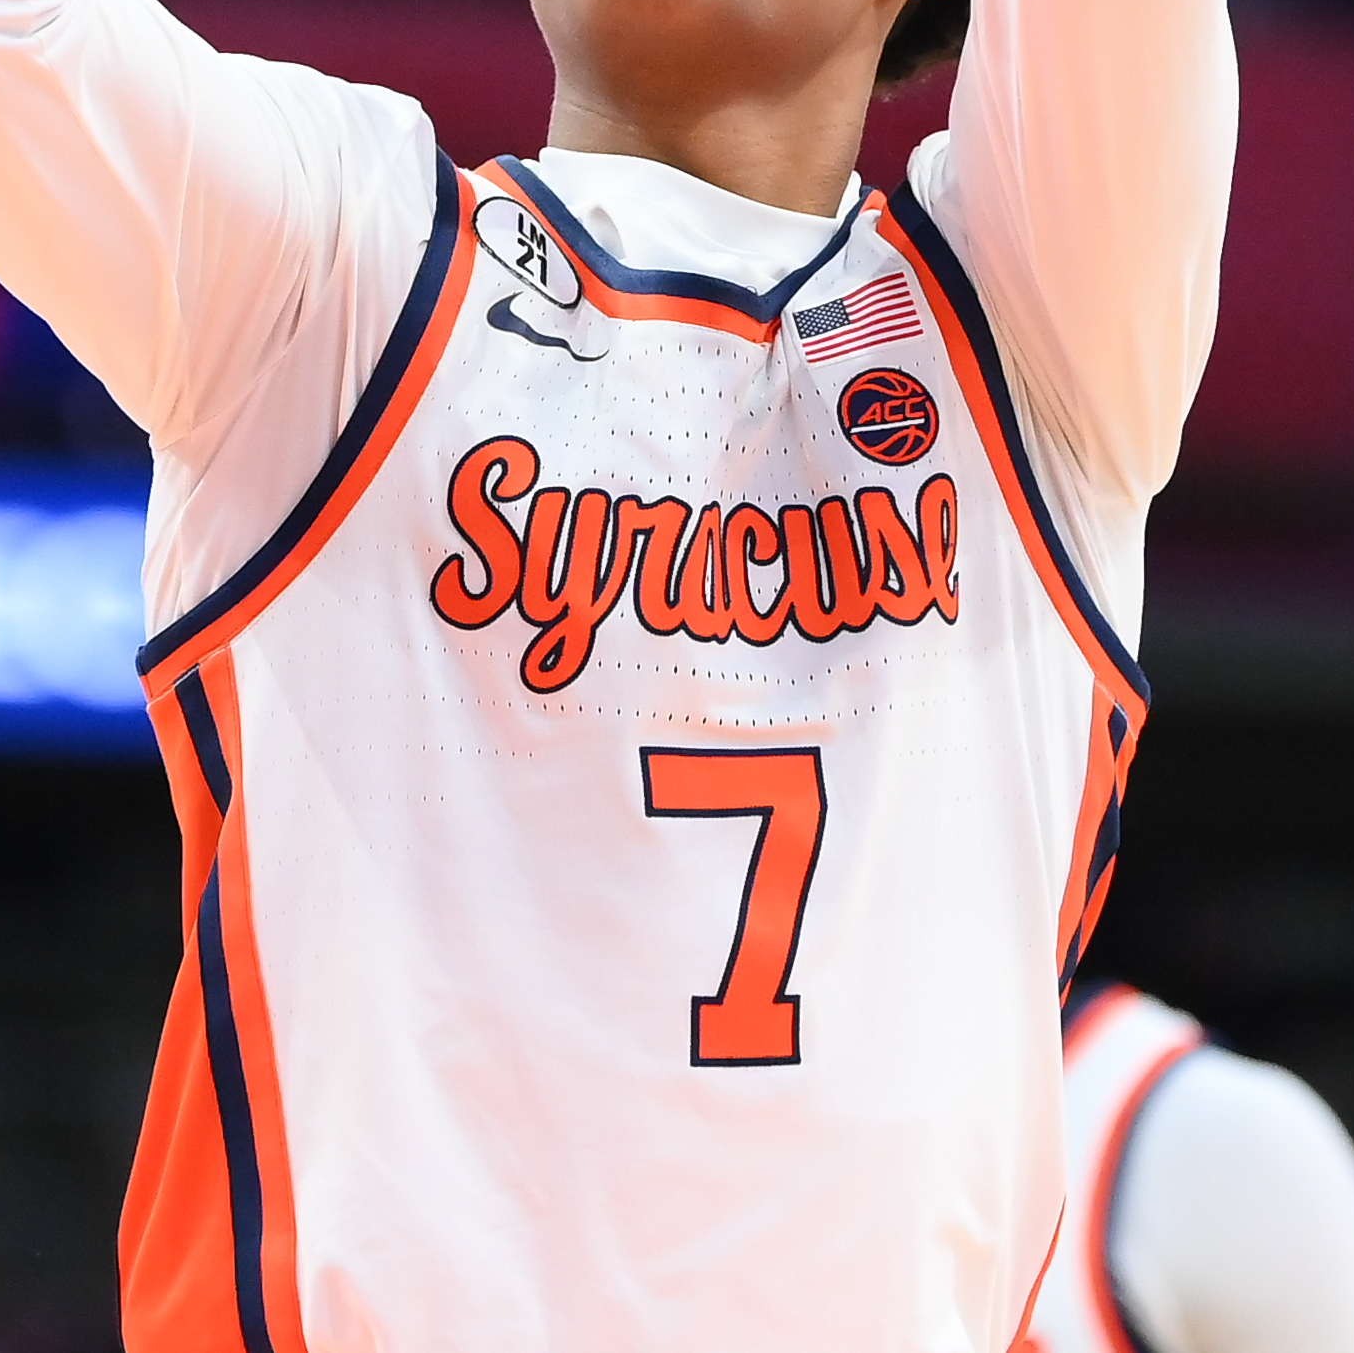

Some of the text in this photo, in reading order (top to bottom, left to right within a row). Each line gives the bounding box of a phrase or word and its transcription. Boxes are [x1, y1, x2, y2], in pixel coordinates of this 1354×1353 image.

[517, 212, 548, 258] LM
[515, 237, 548, 288] 21
[857, 395, 927, 425] ACC
[430, 434, 959, 694] Syracuse
[639, 745, 828, 1067] 7
